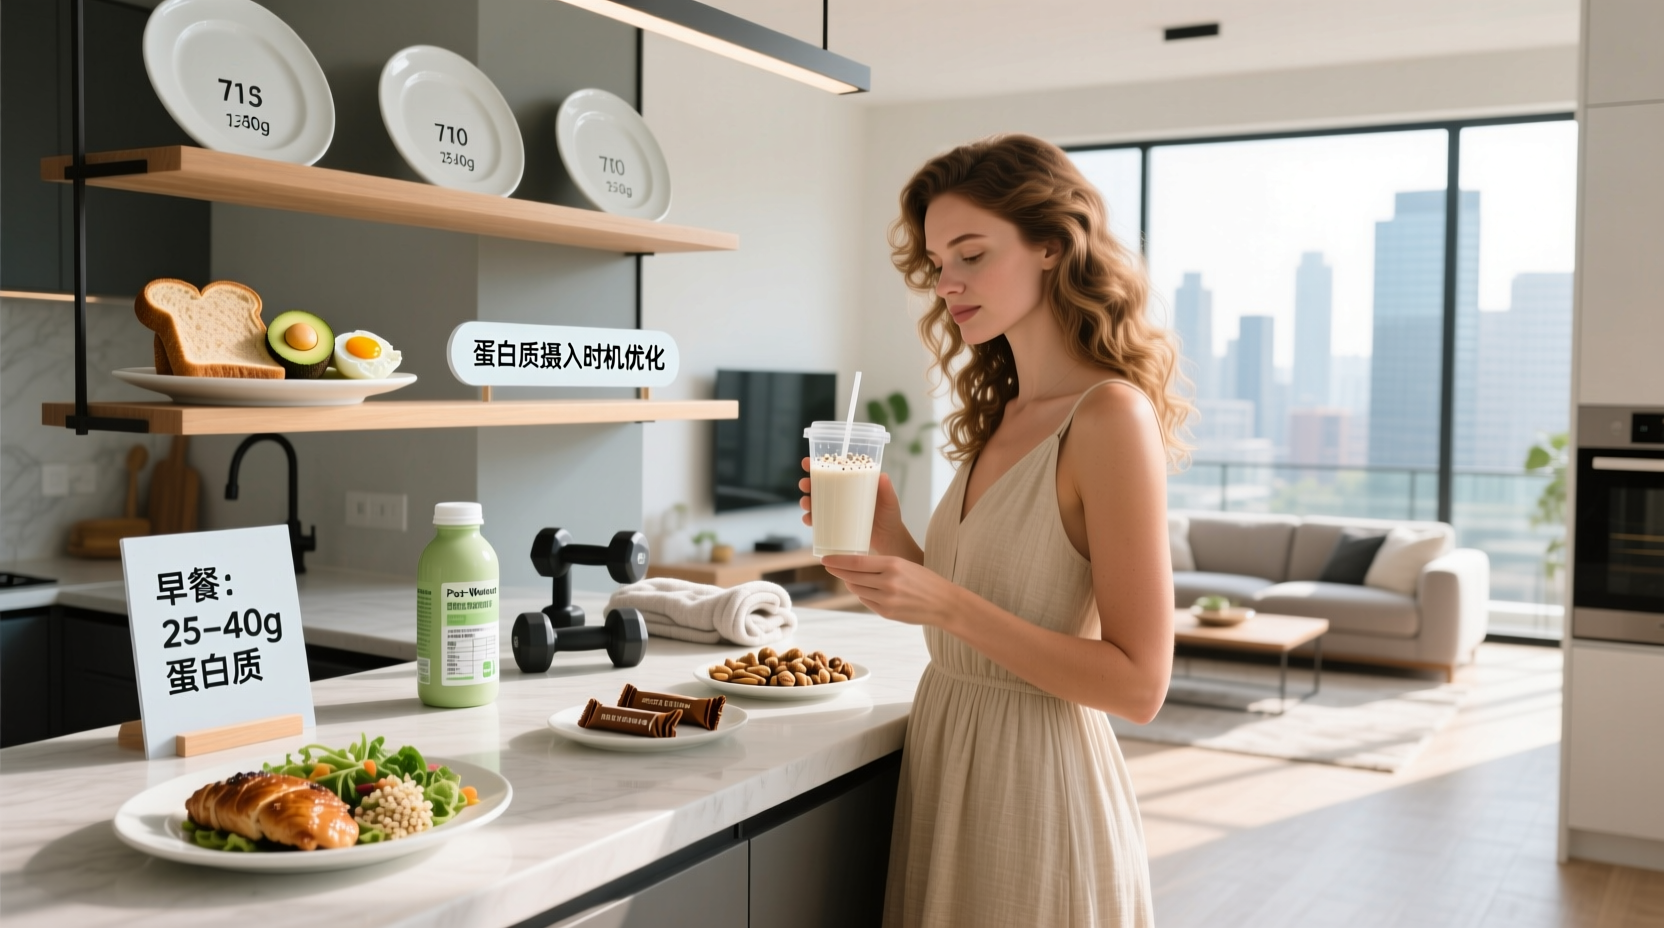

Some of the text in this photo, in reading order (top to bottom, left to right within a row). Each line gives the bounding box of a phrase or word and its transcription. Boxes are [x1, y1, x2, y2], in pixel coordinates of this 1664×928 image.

[434, 123, 468, 146] 710
[473, 339, 665, 371] 蛋白质摄入时机优化
[166, 647, 263, 695] 蛋白质
